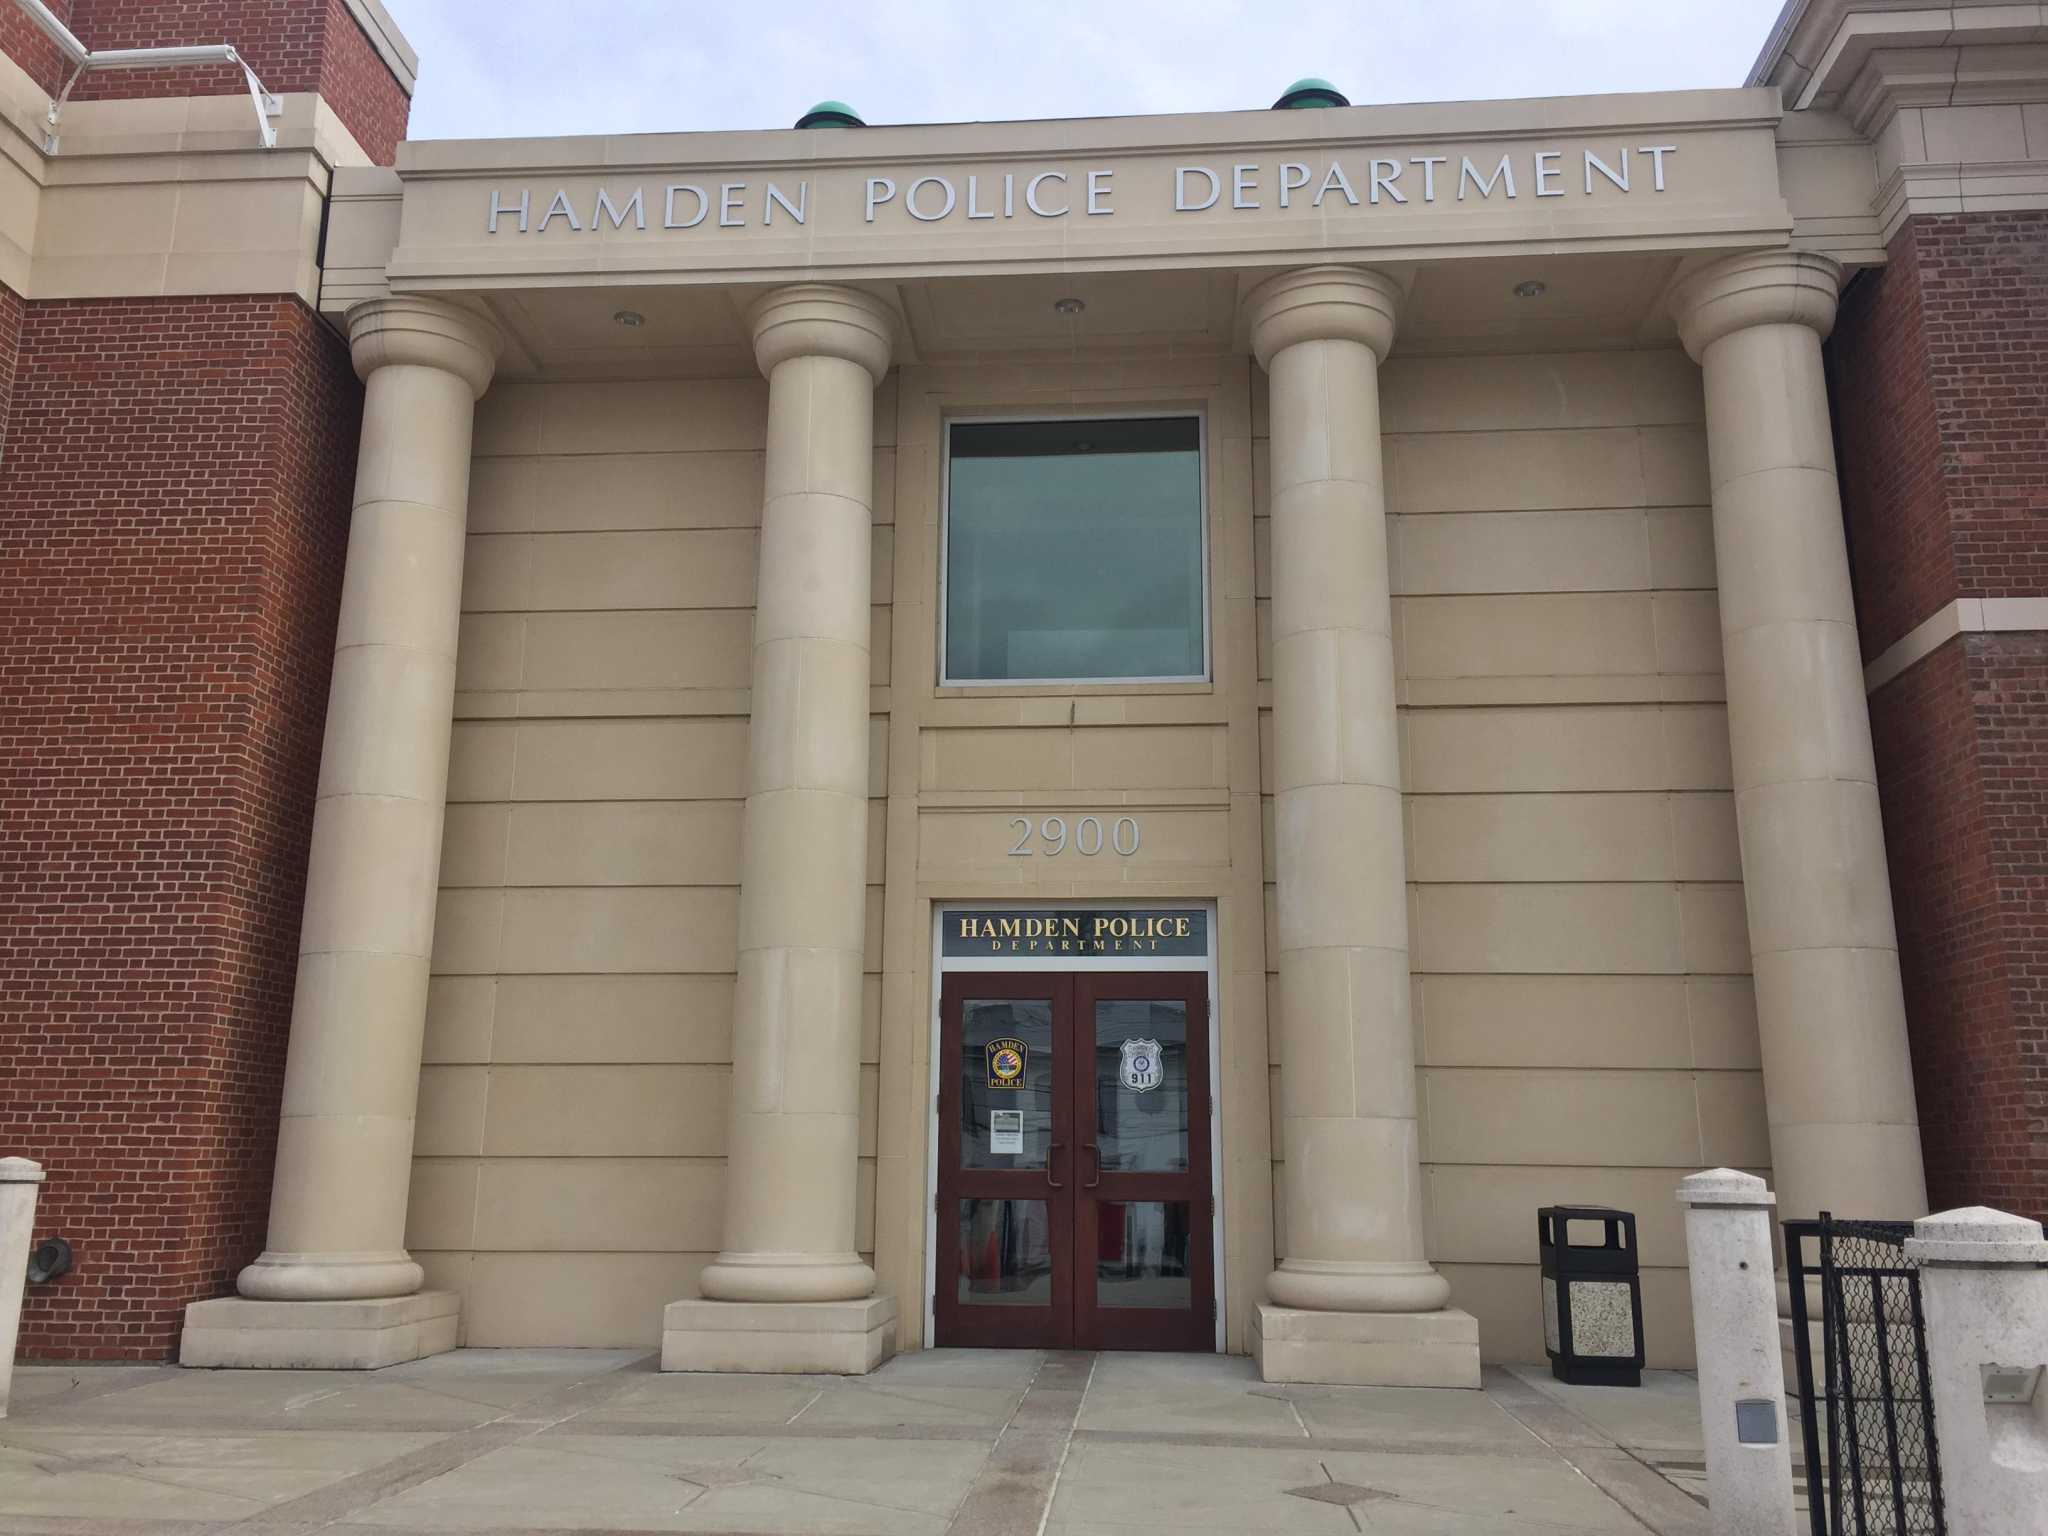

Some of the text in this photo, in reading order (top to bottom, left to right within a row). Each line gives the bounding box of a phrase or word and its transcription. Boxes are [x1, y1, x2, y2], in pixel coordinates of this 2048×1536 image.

[488, 145, 1678, 233] HAMDEN POLICE DEPARTMENT
[1007, 816, 1141, 857] 2900
[959, 917, 1190, 938] HAMDEN POLICE
[991, 939, 1160, 951] DEPARTMENT
[988, 1039, 1026, 1054] HAMDEN
[991, 1078, 1023, 1087] POLICE
[1131, 1073, 1152, 1084] 911
